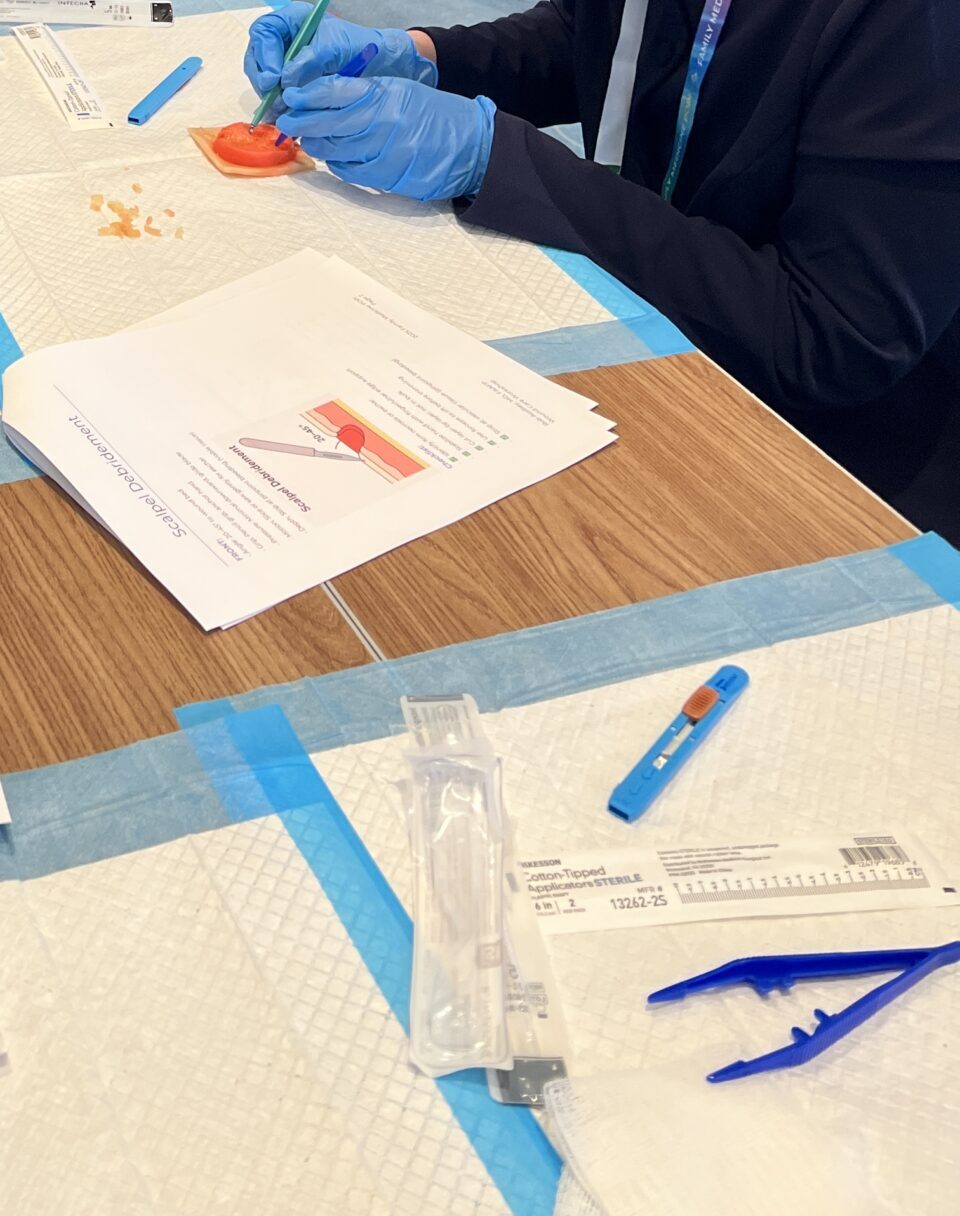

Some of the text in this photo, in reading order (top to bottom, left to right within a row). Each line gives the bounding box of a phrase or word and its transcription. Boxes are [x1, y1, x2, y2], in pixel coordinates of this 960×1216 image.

[697, 24, 714, 67] FAMILY
[66, 414, 188, 539] Scalpel Debridement
[228, 444, 280, 487] Debridement
[277, 486, 311, 512] Scalpel
[215, 537, 243, 561] FRONT:
[519, 858, 562, 868] KESSON
[528, 873, 643, 894] Applicators STERILE
[636, 886, 656, 894] MFR
[534, 900, 554, 911] 6 in
[568, 898, 577, 908] 2
